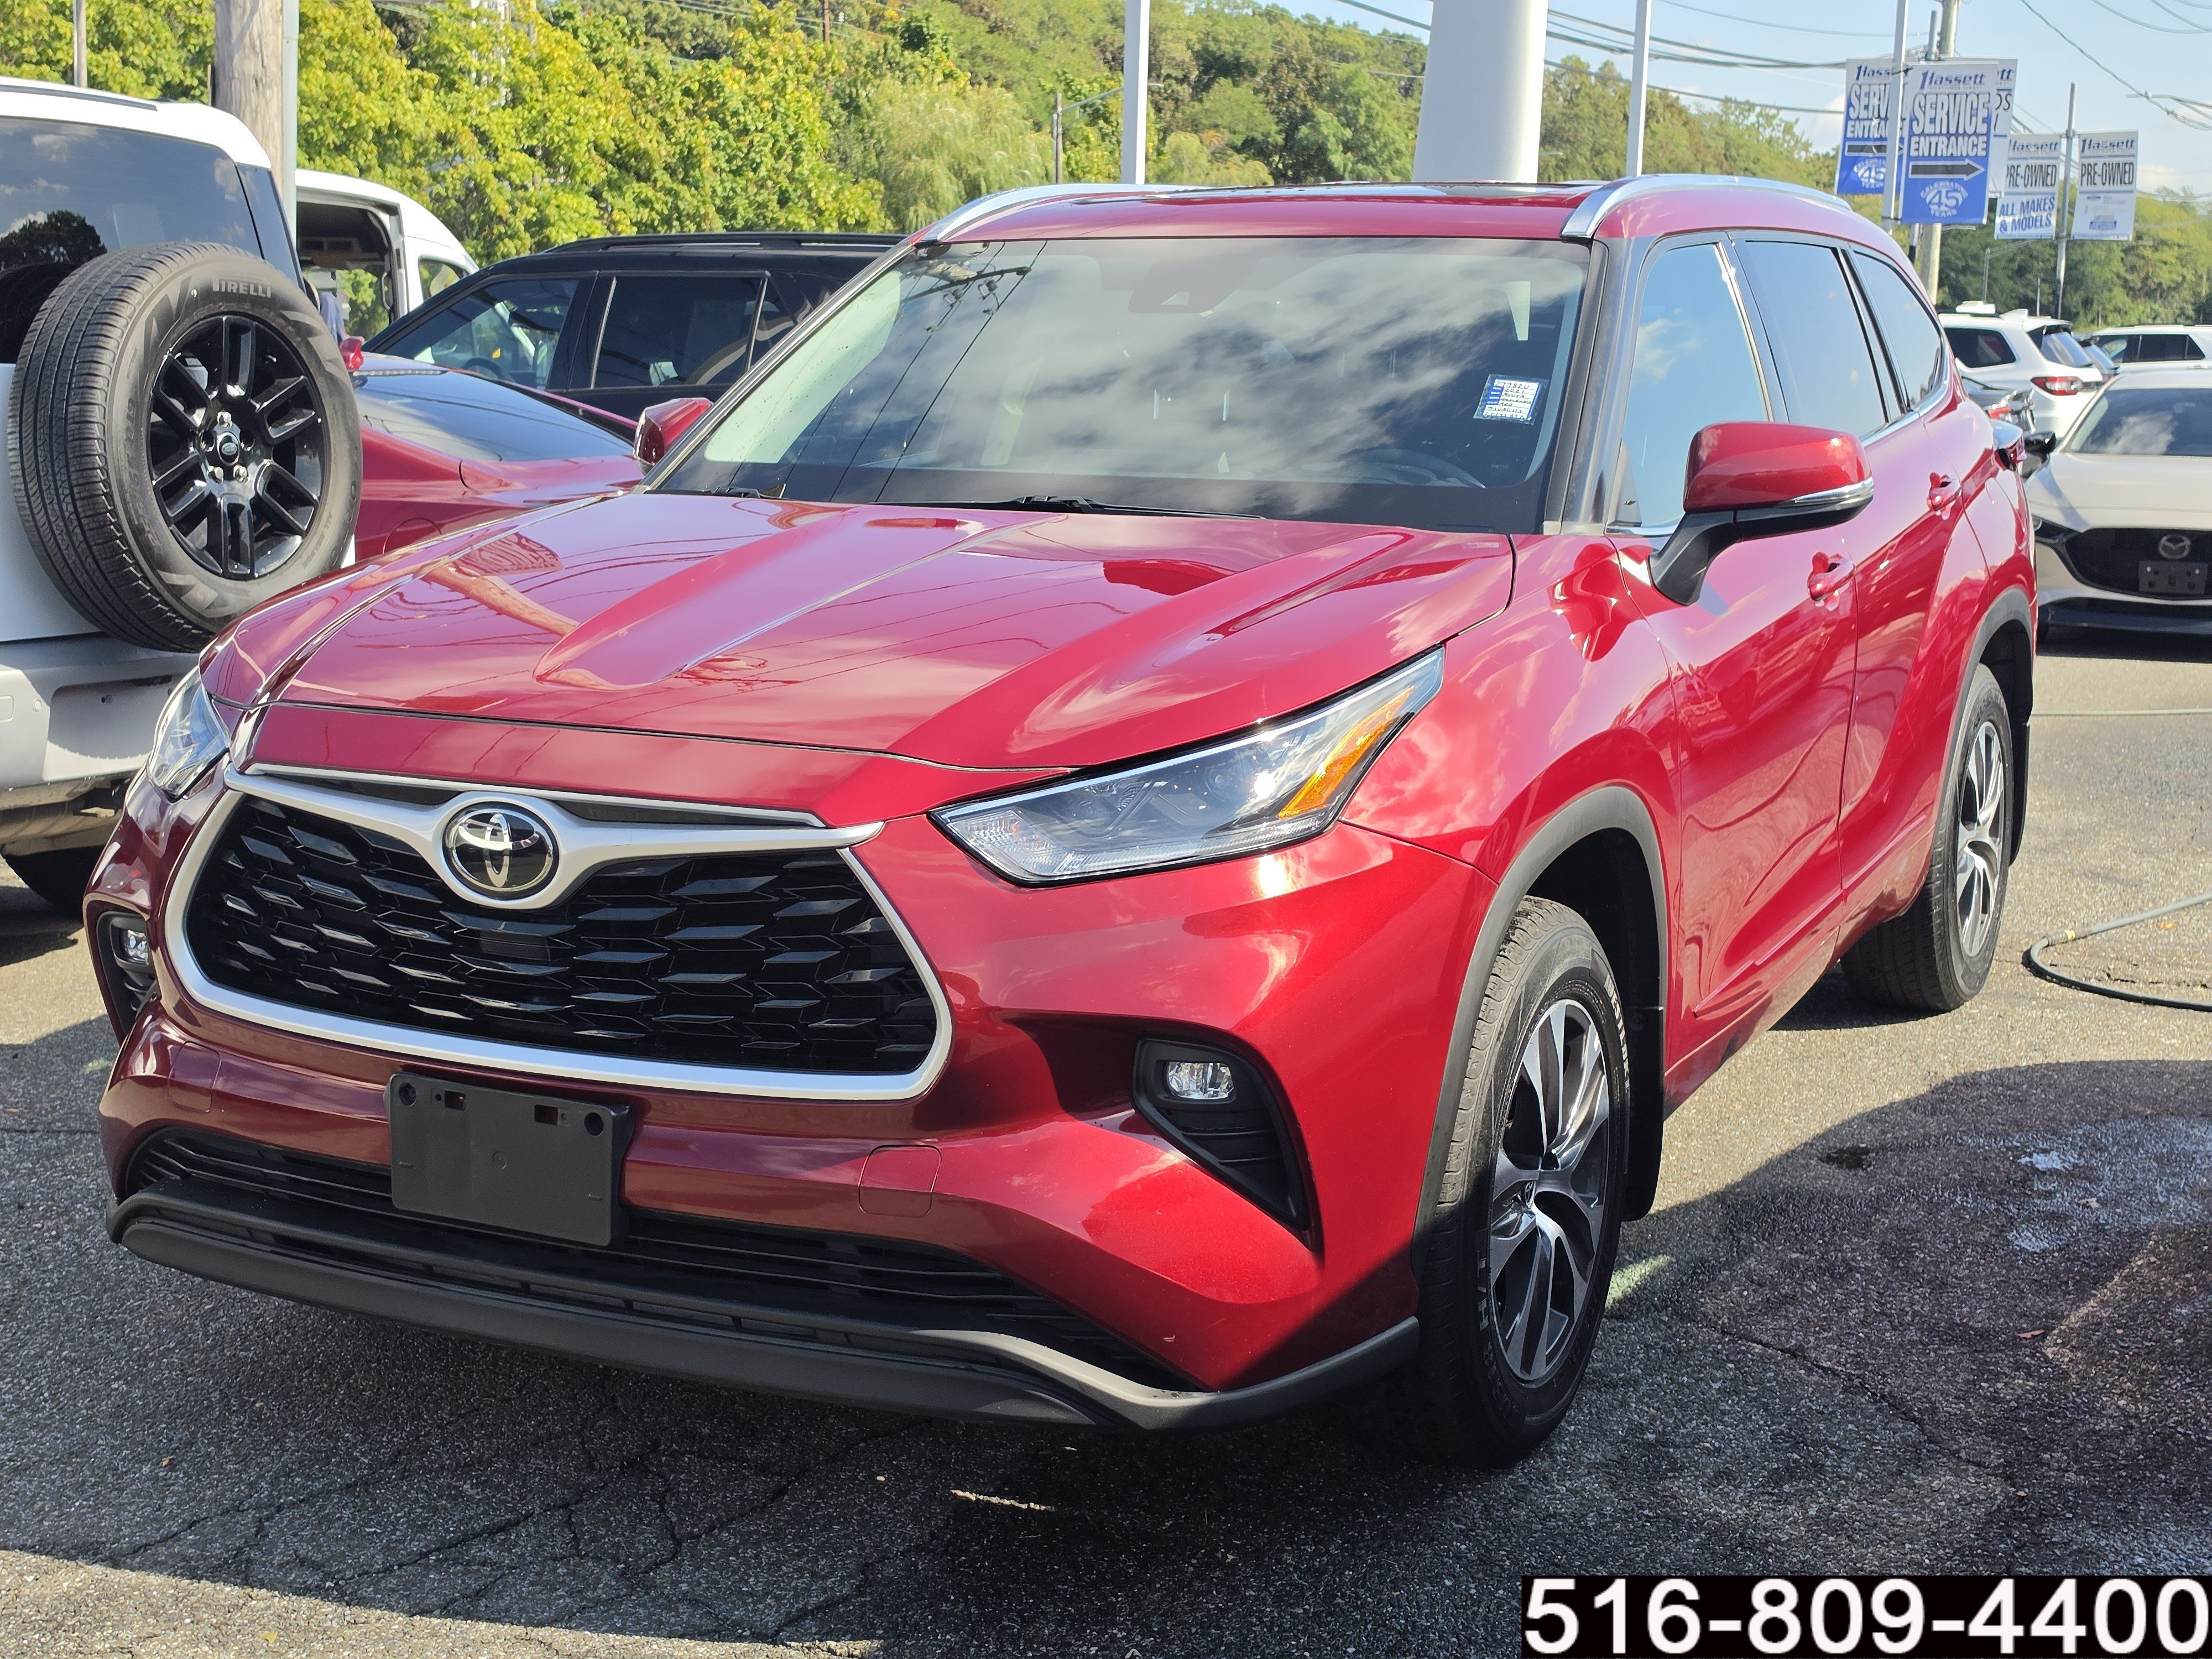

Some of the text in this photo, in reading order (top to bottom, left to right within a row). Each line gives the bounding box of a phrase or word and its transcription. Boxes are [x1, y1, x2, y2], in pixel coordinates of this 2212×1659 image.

[1856, 65, 1891, 80] Hass
[1919, 70, 1985, 90] Hassett
[1849, 84, 1890, 119] SERV
[1912, 92, 1991, 134] SERVICE
[1846, 119, 1890, 138] ENTRA
[1910, 136, 1987, 156] ENTRANCE
[2080, 138, 2135, 153] Hassett
[2080, 161, 2135, 187] PRE-OWNED
[1926, 187, 1963, 208] 45
[1999, 196, 2056, 217] ALL MAKES
[1999, 213, 2052, 233] & MODELS
[1604, 972, 1630, 1094] WESTLAKE
